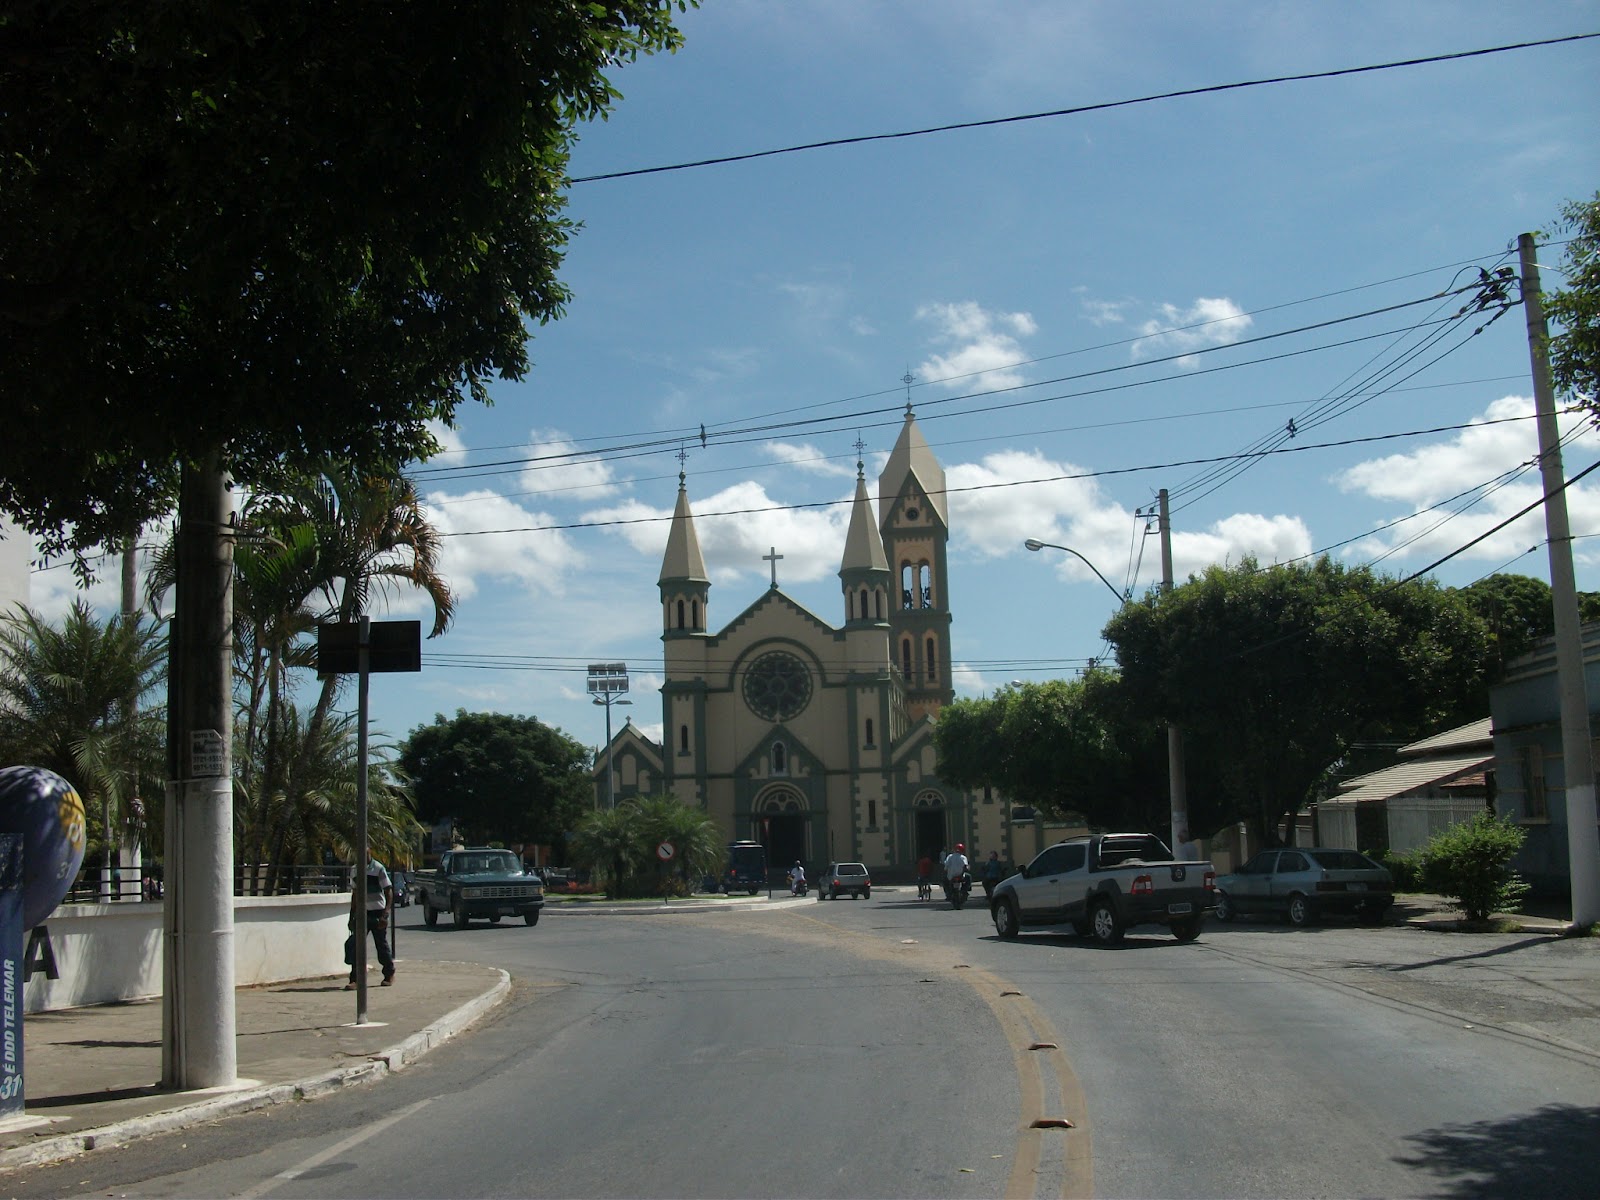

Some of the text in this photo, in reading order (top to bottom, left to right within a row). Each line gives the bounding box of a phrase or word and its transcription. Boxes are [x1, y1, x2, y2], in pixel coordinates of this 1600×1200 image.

[57, 862, 72, 879] 31
[24, 926, 59, 982] A
[1, 958, 21, 1100] 31 É DDD TELEMAR
